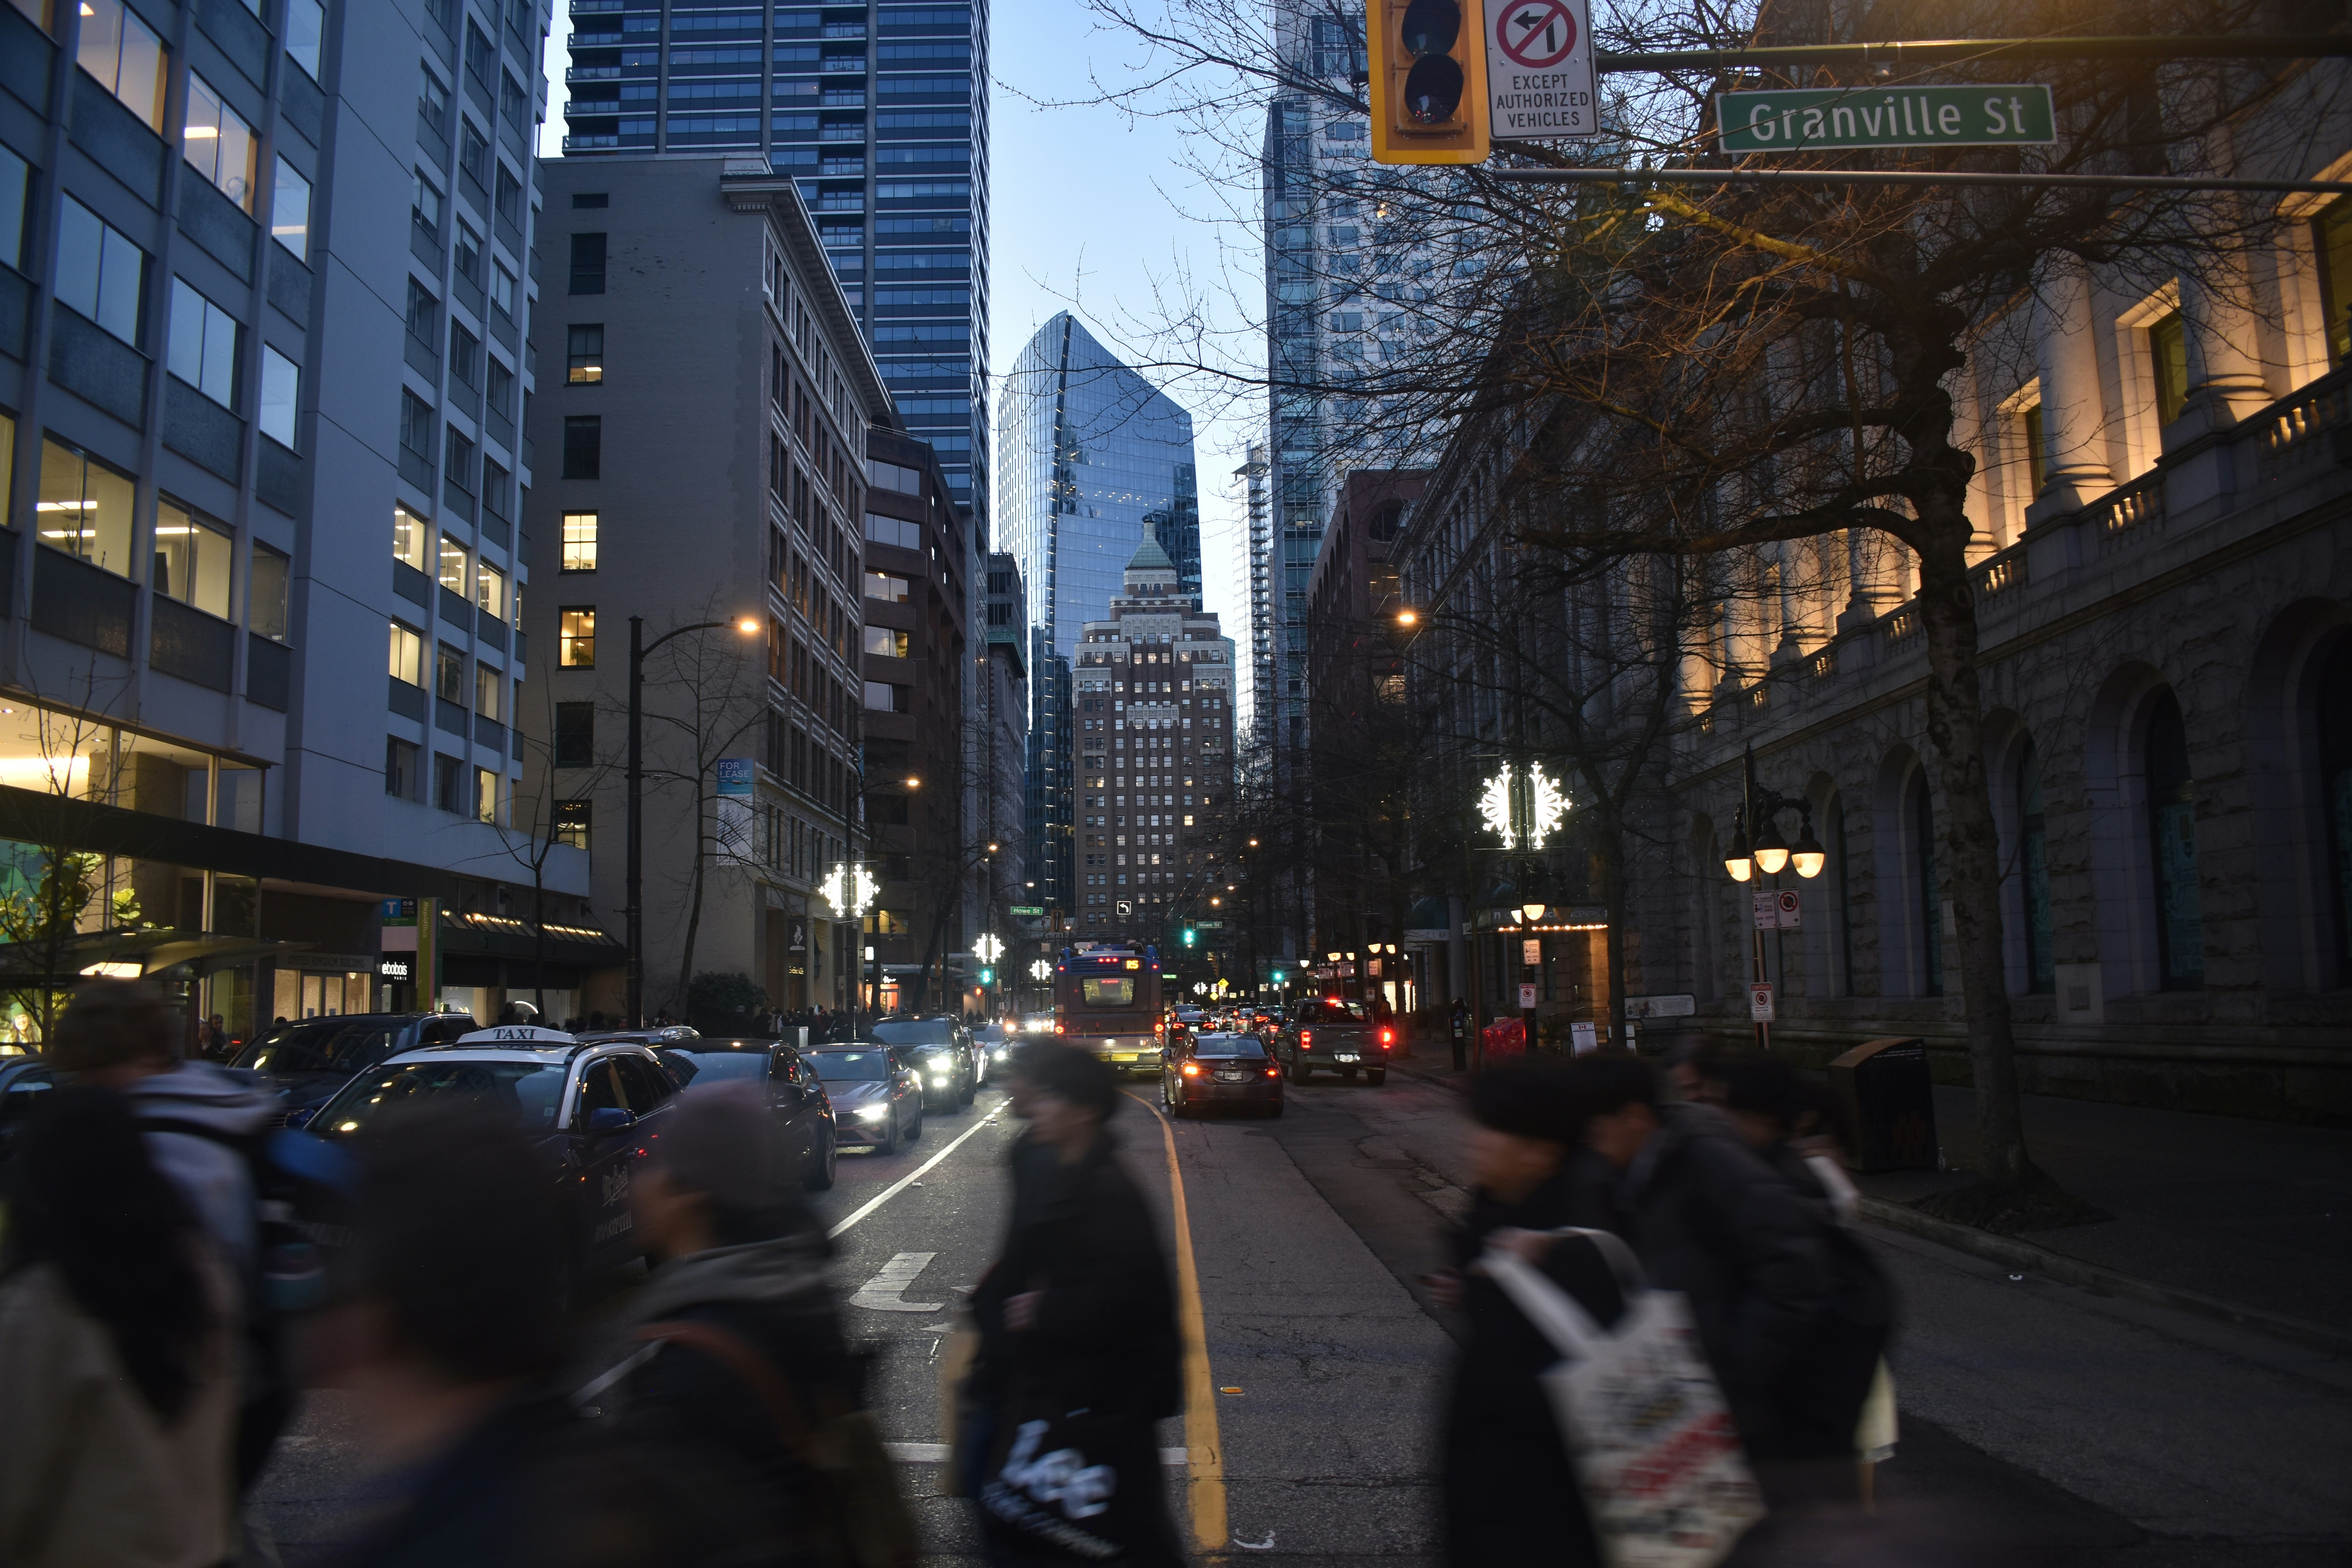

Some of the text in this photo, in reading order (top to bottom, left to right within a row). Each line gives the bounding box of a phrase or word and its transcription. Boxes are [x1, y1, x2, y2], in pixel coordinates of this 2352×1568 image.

[1513, 74, 1567, 90] EXCEPT
[1496, 92, 1588, 109] AUTHORIZED
[1507, 111, 1580, 128] VEHICLES
[1749, 96, 2025, 141] Granville St
[288, 955, 365, 967] UNITED KINGDOM BUILDING
[382, 961, 407, 975] ebobois
[1127, 960, 1138, 969] R5
[493, 1029, 536, 1039] TAXI
